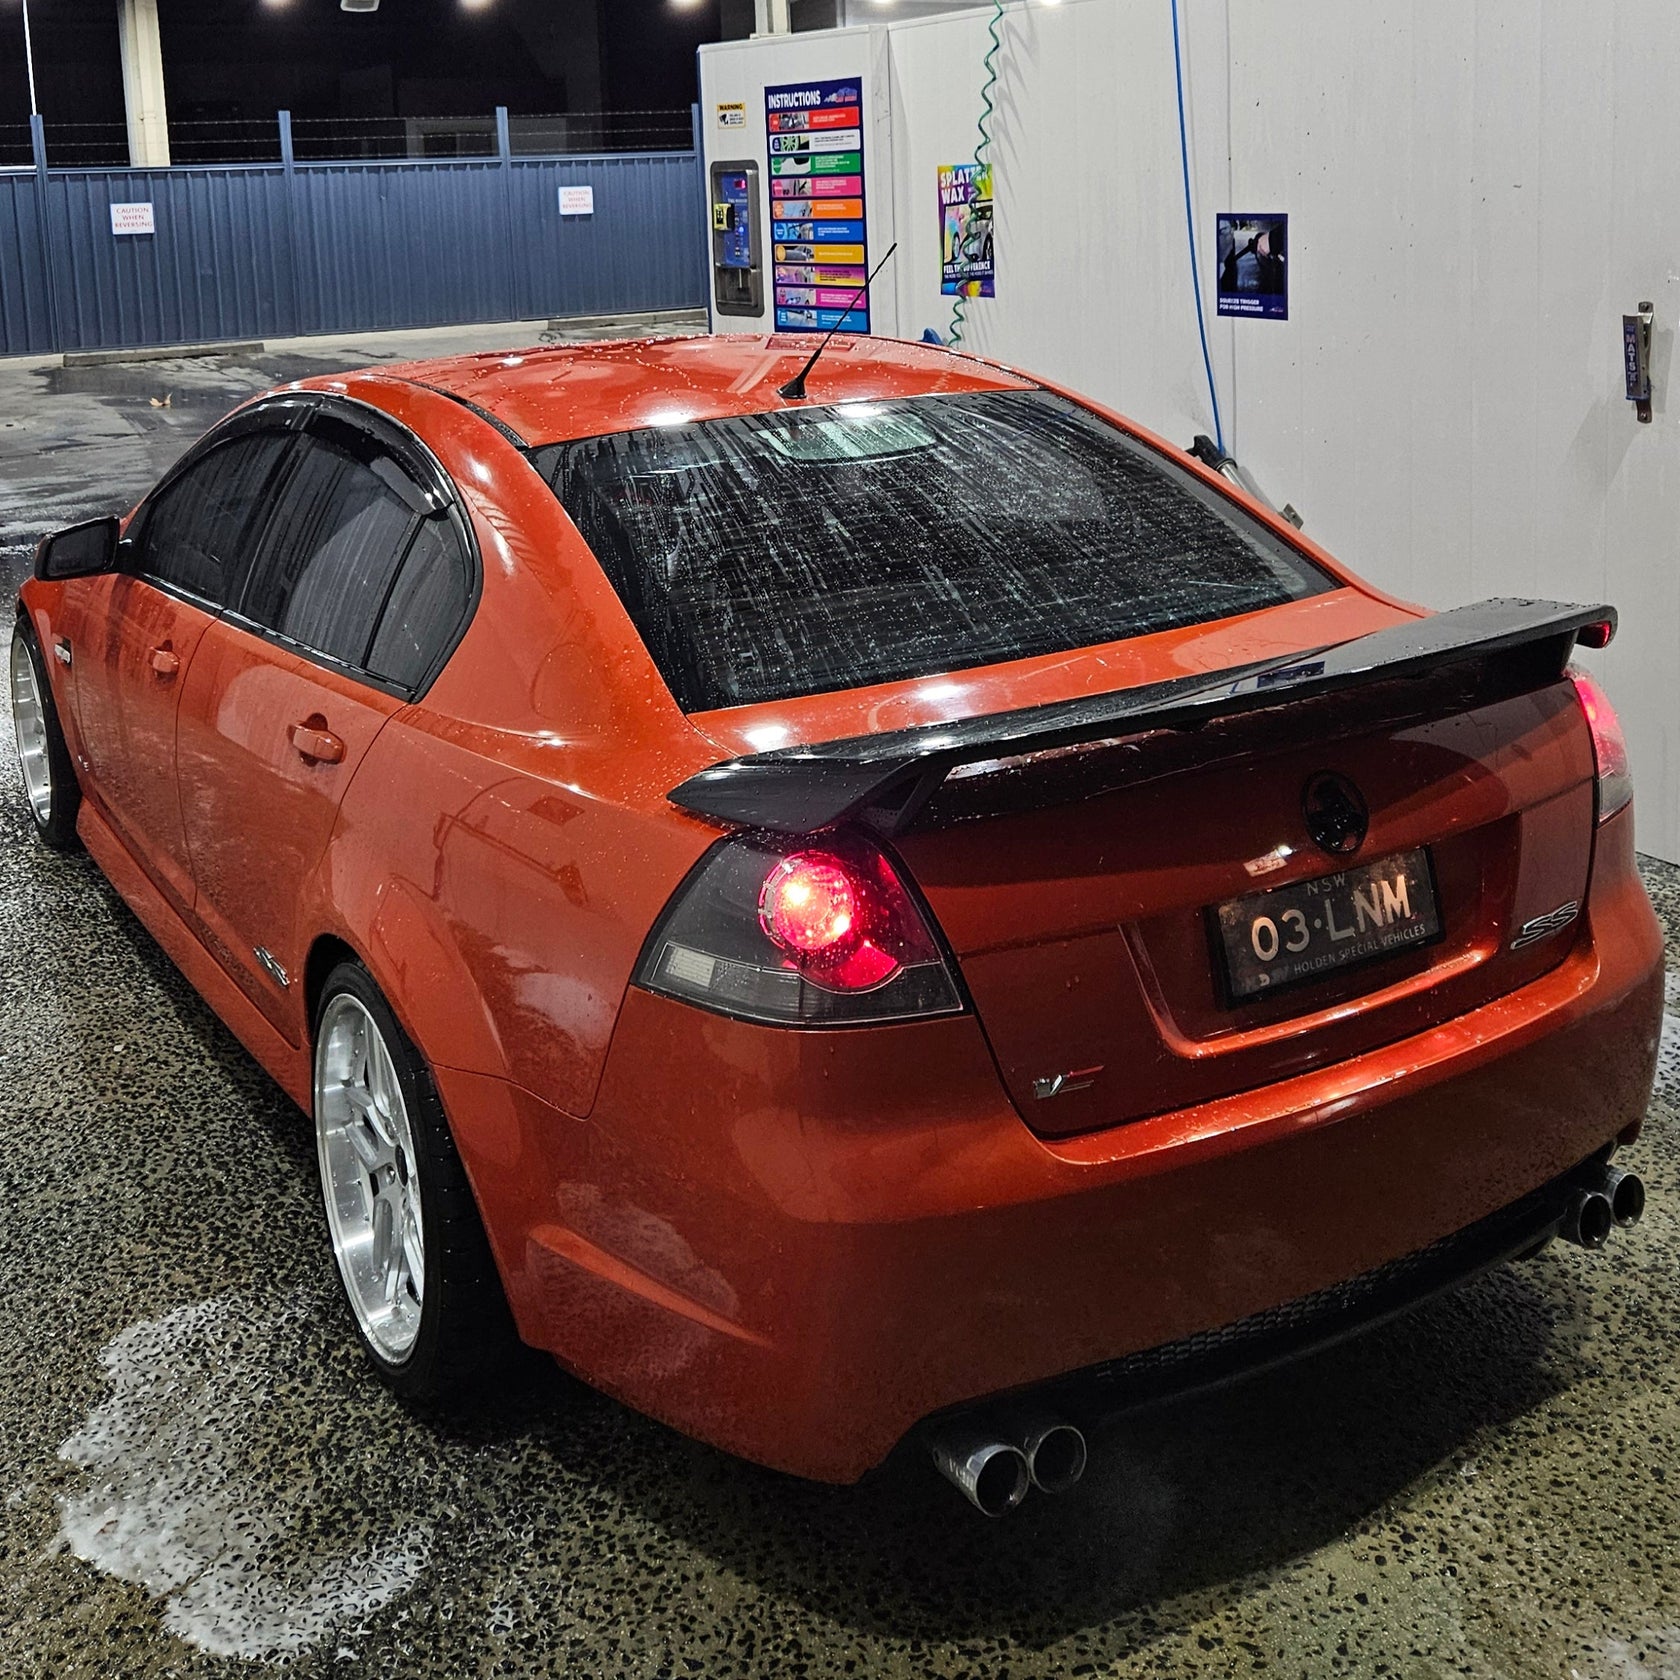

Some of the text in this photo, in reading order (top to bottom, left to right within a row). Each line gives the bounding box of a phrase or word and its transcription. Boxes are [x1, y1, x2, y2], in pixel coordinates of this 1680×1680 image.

[719, 103, 743, 111] WARNING
[768, 90, 821, 109] INSTRUCTIONS
[941, 185, 965, 204] WAX
[943, 264, 954, 274] FEEL
[1625, 334, 1636, 370] MATS
[1306, 873, 1346, 896] NSW
[1510, 900, 1578, 950] SS
[1294, 923, 1427, 974] HOLDEN SPECIAL VEHICLES
